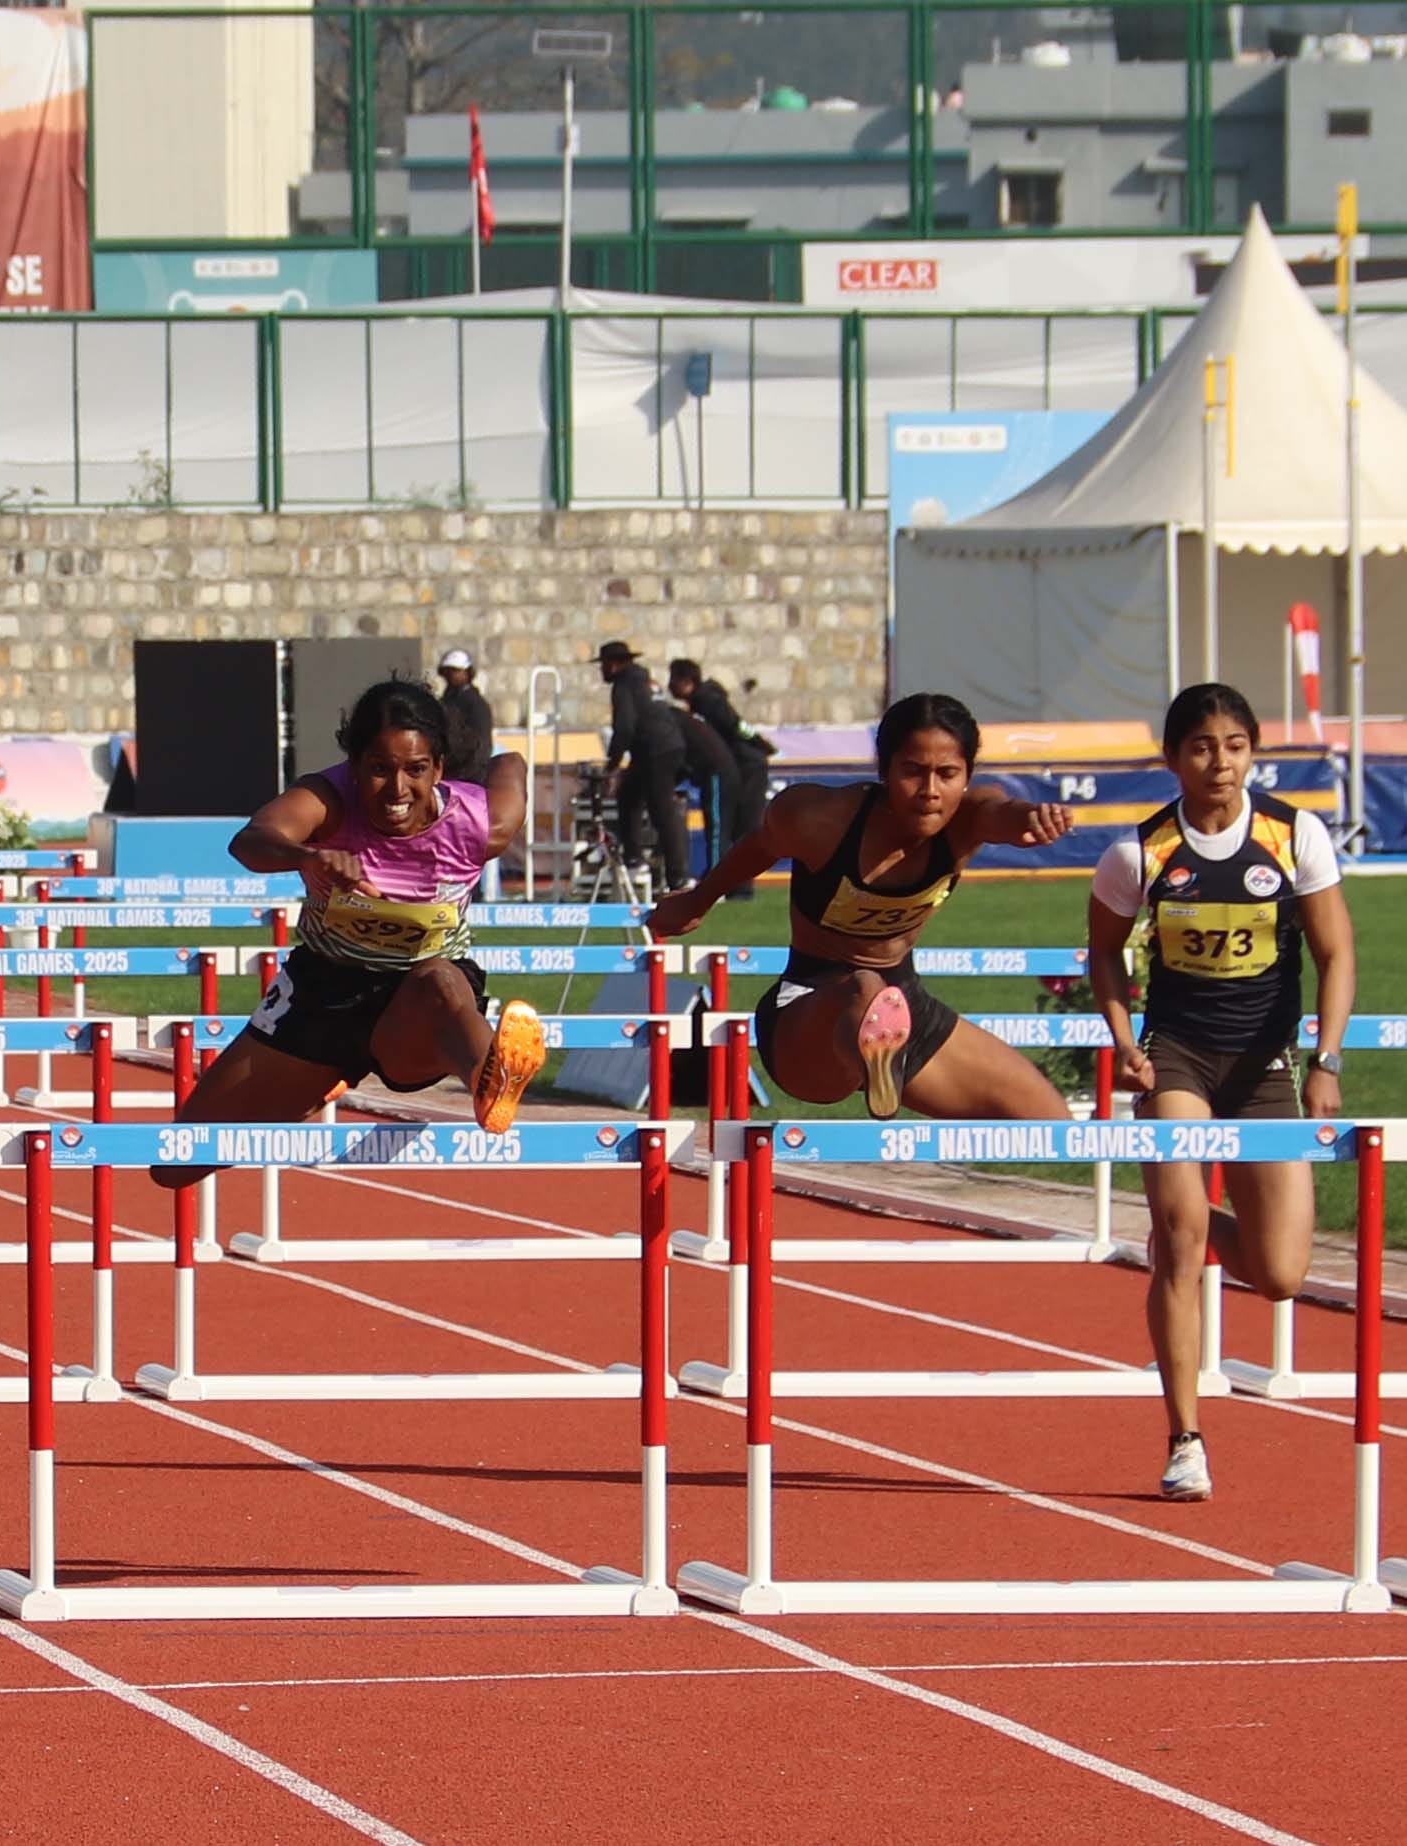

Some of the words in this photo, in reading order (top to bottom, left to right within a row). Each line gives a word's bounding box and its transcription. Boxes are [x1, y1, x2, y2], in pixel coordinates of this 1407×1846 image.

[6, 255, 43, 295] SE
[842, 262, 933, 288] CLEAR
[1060, 775, 1097, 801] P-6
[97, 878, 121, 894] 38TH
[124, 878, 180, 894] NATIONAL
[184, 878, 231, 895] GAMES,
[234, 878, 267, 894] 2025
[16, 909, 44, 926] 38TH
[47, 909, 112, 926] NATIONAL
[116, 909, 170, 927] GAMES,
[174, 909, 211, 926] 2025
[496, 905, 549, 927] GAMES,
[552, 905, 590, 925] 2025
[1181, 928, 1253, 959] 373
[16, 953, 80, 976] GAMES,
[84, 953, 128, 974] 2025
[531, 949, 575, 971] 2025
[915, 951, 979, 975] GAMES,
[981, 951, 1027, 973] 2025
[158, 1128, 210, 1162] 38TH
[217, 1128, 339, 1162] NATIONAL
[346, 1128, 444, 1165] GAMES,
[451, 1128, 522, 1162] 2025
[880, 1126, 931, 1160] 38TH
[938, 1126, 1059, 1160] NATIONAL
[1066, 1126, 1164, 1163] GAMES,
[1171, 1126, 1241, 1160] 2025
